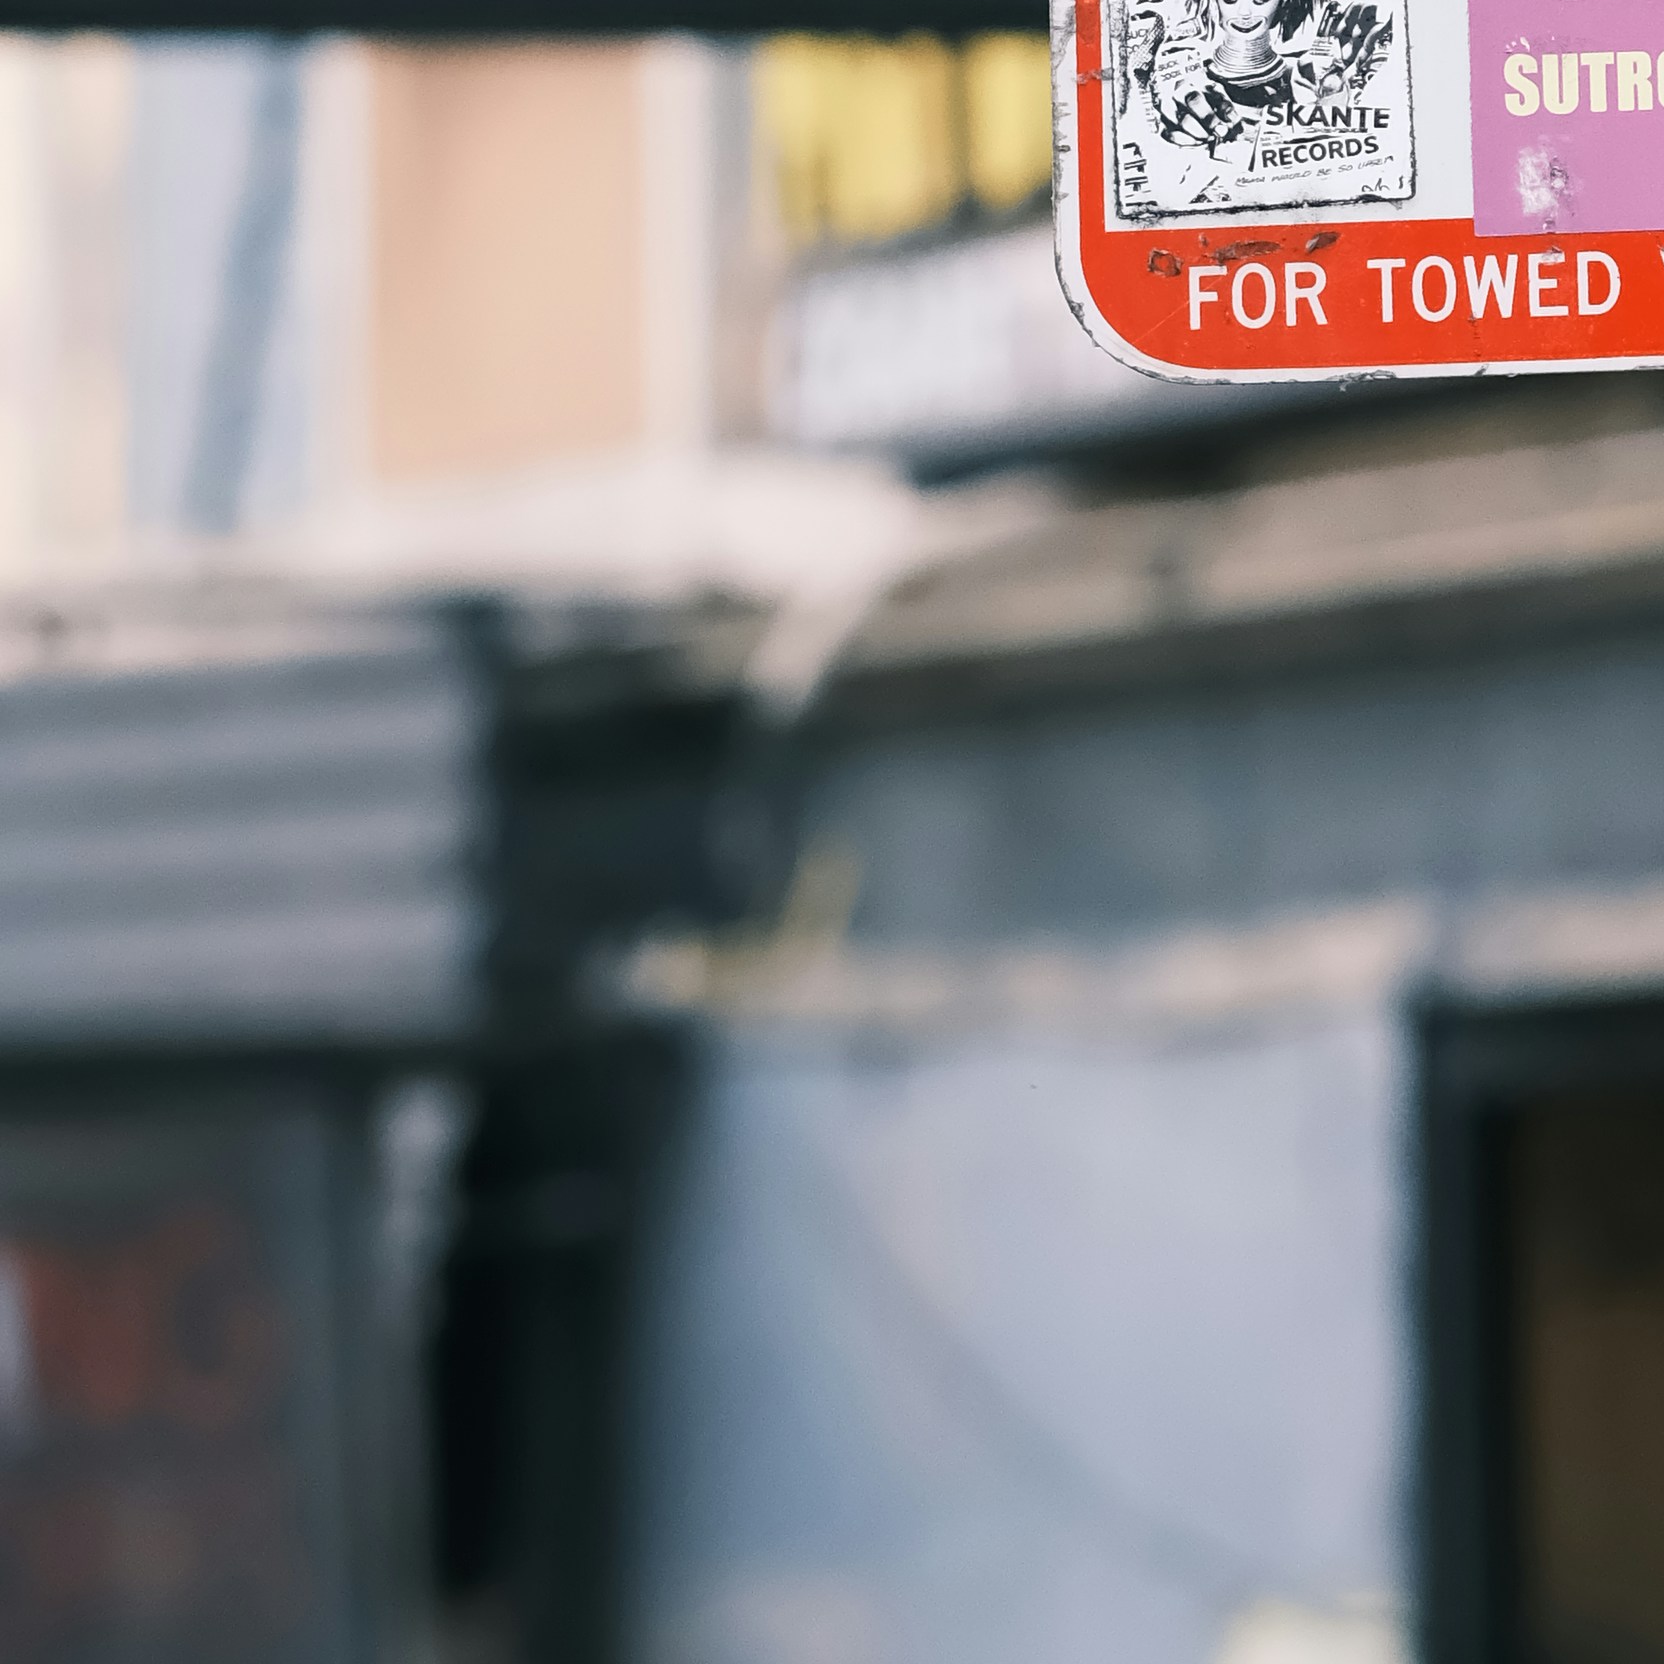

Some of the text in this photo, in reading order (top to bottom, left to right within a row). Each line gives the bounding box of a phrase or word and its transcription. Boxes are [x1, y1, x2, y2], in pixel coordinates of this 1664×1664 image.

[1265, 103, 1391, 129] SKANTE
[1260, 135, 1380, 169] RECORDS
[1188, 262, 1329, 332] FOR
[1368, 249, 1622, 325] TOWED
